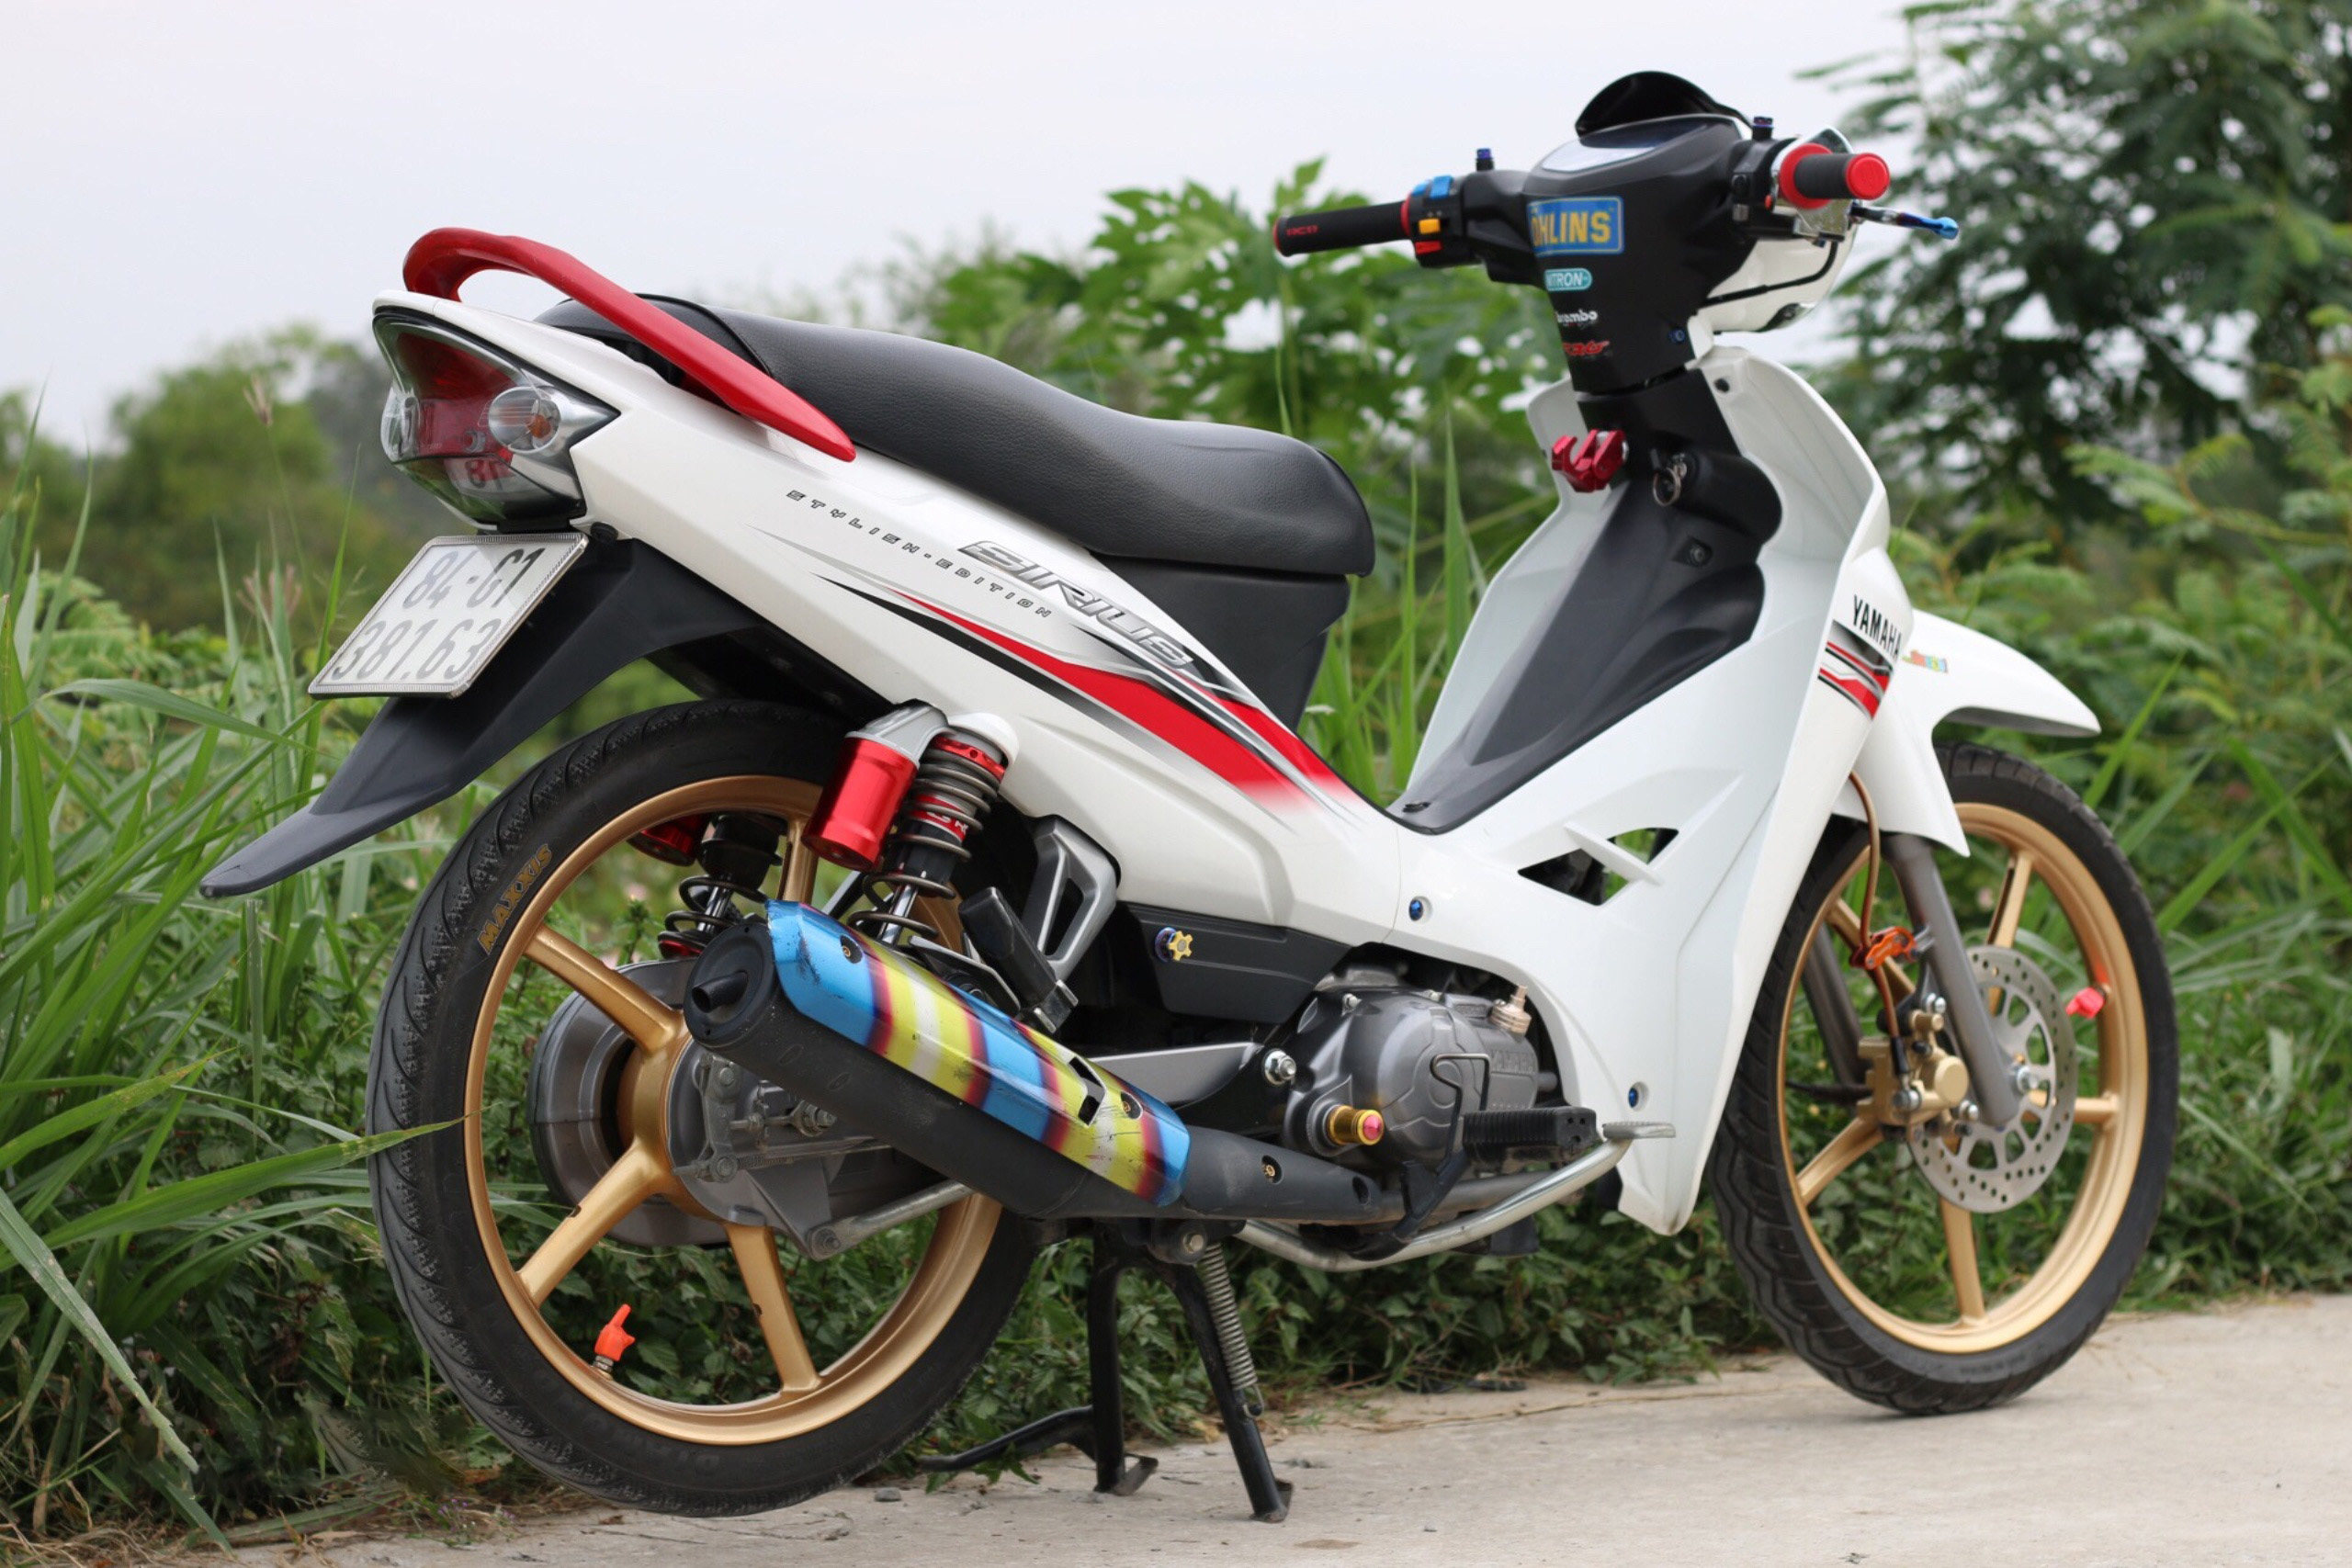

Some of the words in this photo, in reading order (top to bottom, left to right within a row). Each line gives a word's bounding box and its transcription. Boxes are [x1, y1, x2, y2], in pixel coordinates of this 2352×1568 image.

[958, 540, 1194, 667] SIRIUS
[1853, 594, 1901, 660] YAMAHA
[332, 619, 502, 681] 381.63
[478, 843, 552, 954] MAXXIS
